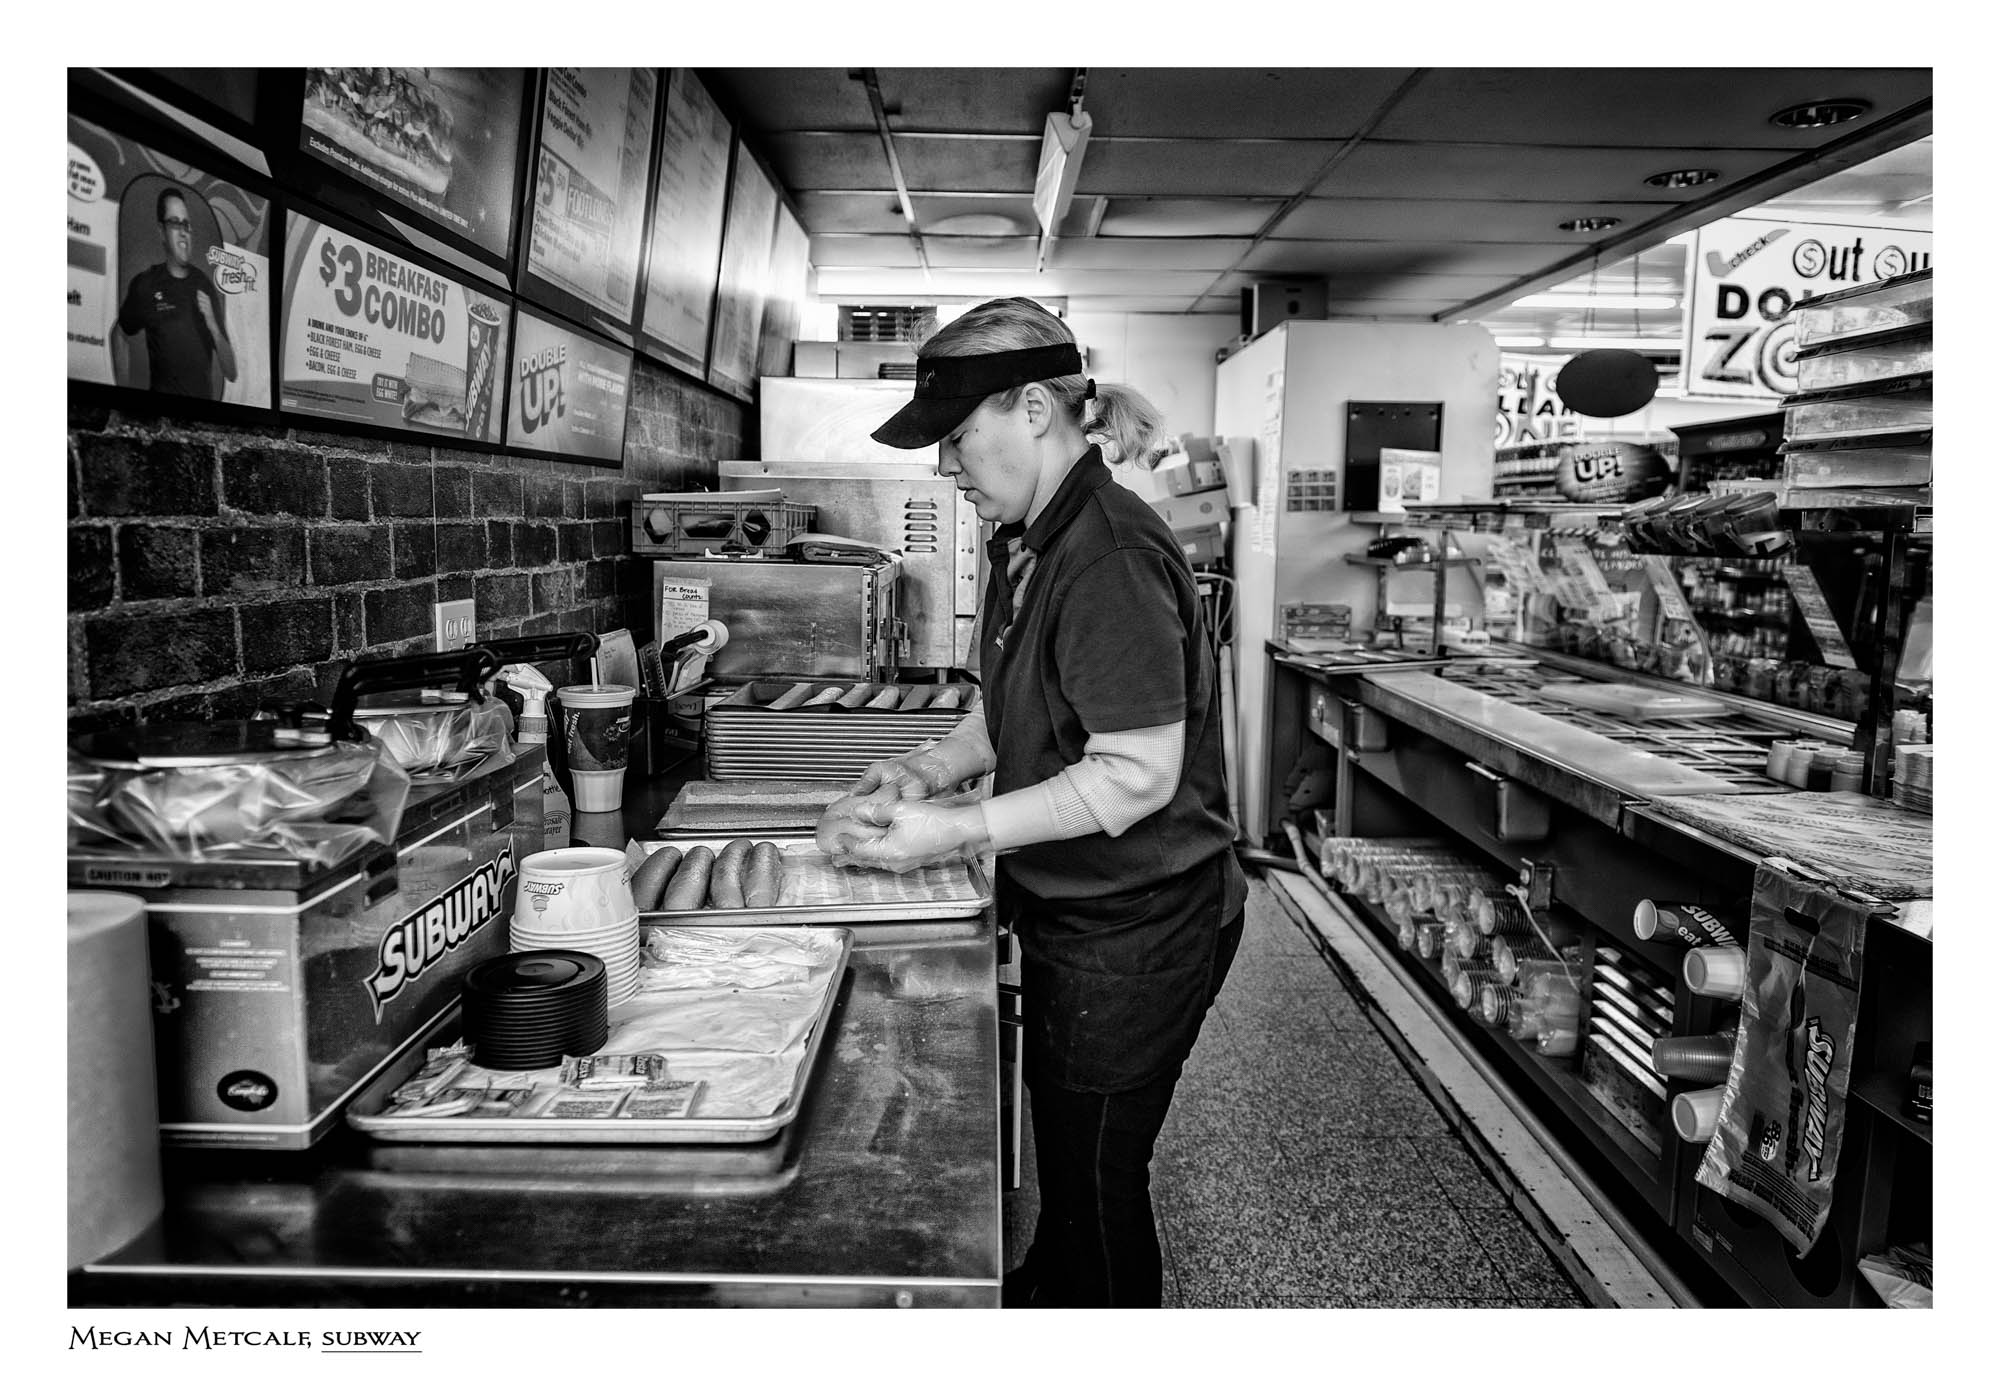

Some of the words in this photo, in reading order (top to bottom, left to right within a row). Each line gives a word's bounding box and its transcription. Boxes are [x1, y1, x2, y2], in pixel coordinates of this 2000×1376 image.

[222, 267, 248, 285] fresh
[319, 237, 362, 317] $3
[366, 251, 448, 306] BREAKFAST
[364, 285, 445, 344] COMBO
[309, 345, 320, 358] EGG
[325, 349, 341, 363] CHEESE
[355, 343, 364, 355] EGG
[367, 346, 382, 359] CHEESE
[521, 344, 566, 380] DOUBLE
[327, 363, 336, 376] EGG
[341, 367, 357, 380] CHEESE
[465, 328, 491, 432] SUBWAY
[521, 366, 566, 433] UP!
[1575, 455, 1625, 483] UP!
[88, 869, 140, 881] CAUTION
[524, 881, 564, 896] SUBWAY
[369, 849, 515, 1008] SUBWAY
[1678, 926, 1702, 946] eat
[1803, 1015, 1838, 1182] SUBWAY
